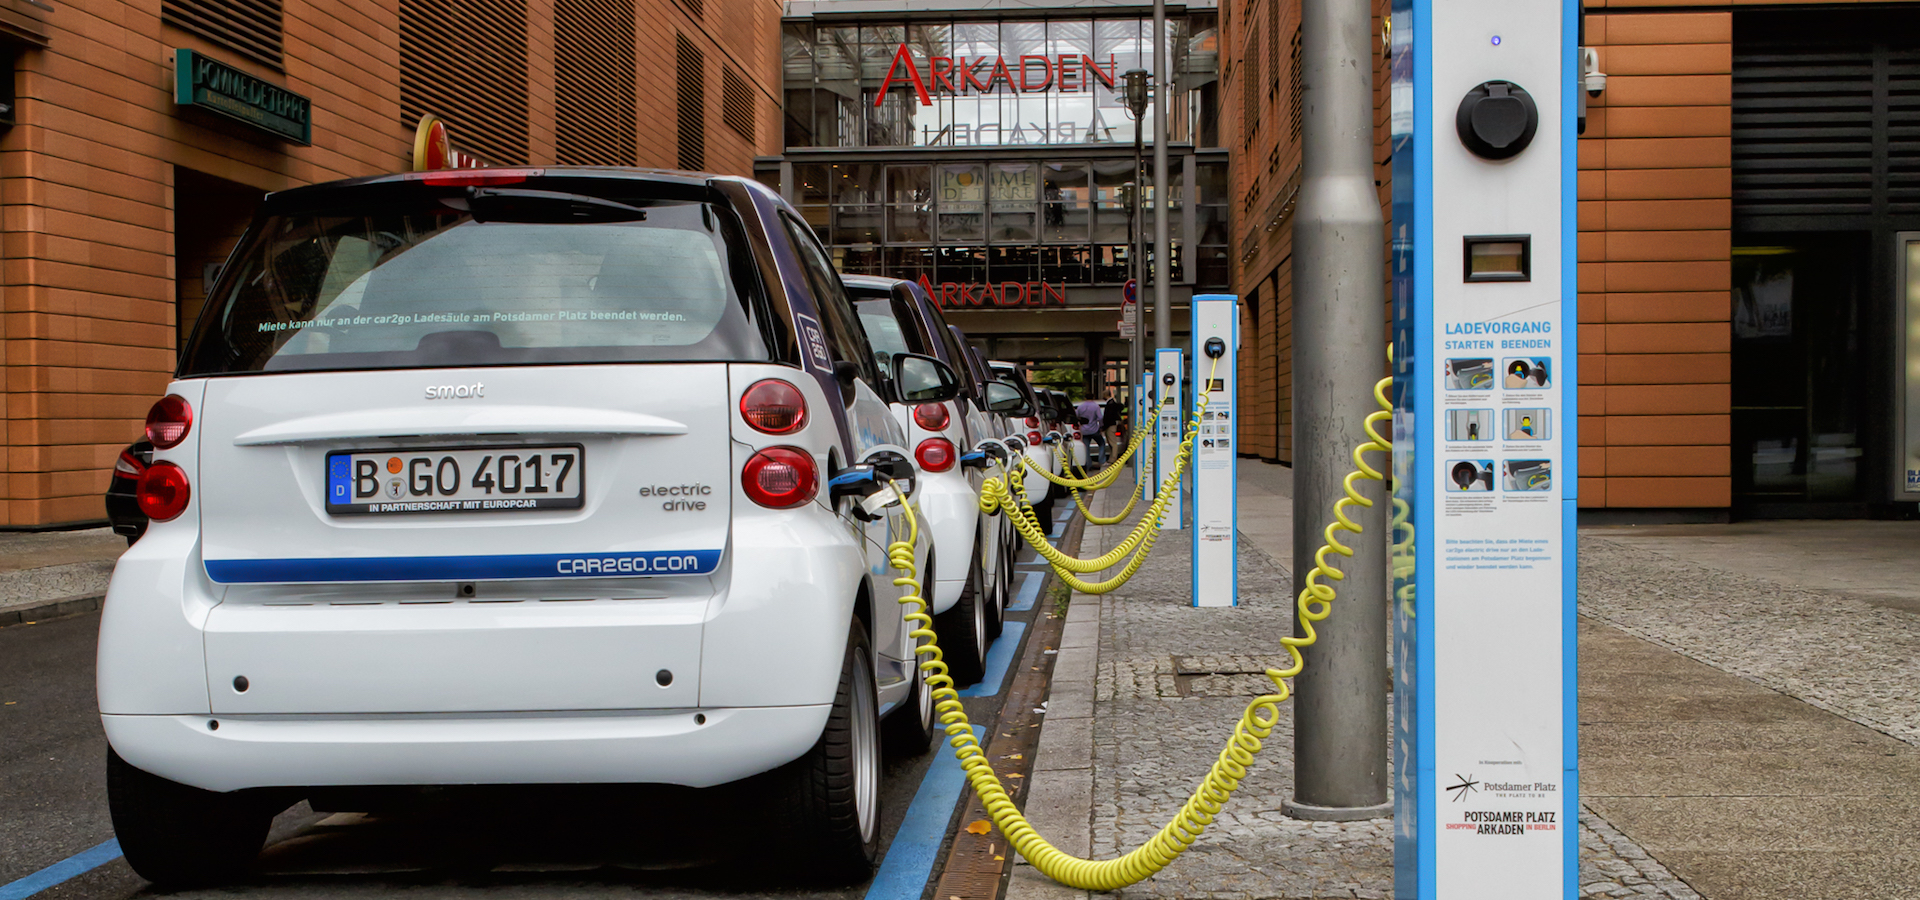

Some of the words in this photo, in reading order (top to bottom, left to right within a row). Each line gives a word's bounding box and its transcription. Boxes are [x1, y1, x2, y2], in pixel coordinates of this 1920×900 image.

[874, 42, 1115, 107] ARKADEN
[194, 58, 247, 100] POMME
[247, 79, 268, 110] DE
[944, 170, 1030, 187] POMME
[944, 187, 967, 200] DE
[917, 273, 1066, 315] ARKADEN
[258, 322, 287, 333] Miete
[289, 319, 314, 330] kann
[317, 318, 335, 327] nur
[337, 317, 350, 326] an
[353, 315, 371, 325] der
[374, 314, 411, 325] car2go
[414, 312, 470, 323] Ladesäule
[473, 314, 490, 322] am
[494, 312, 555, 322] Potsdamer
[559, 310, 587, 320] Platz
[590, 310, 637, 320] beendet
[640, 311, 686, 322] werden.
[1446, 321, 1551, 335] LADEVORGANG
[1445, 340, 1494, 350] STARTEN
[1501, 339, 1551, 349] BEENDEN
[425, 382, 485, 399] smart
[336, 485, 345, 497] D
[355, 460, 379, 498] B
[409, 456, 460, 496] GO
[472, 453, 575, 495] 4017
[639, 481, 712, 497] electric
[369, 504, 379, 513] IN
[382, 502, 461, 512] PARTNERSCHAFT
[464, 501, 481, 510] MIT
[484, 500, 537, 509] EUROPCAR
[662, 497, 706, 512] drive
[557, 555, 698, 574] CAR2GO.COM
[1484, 782, 1532, 792] Potsdamer
[1534, 782, 1556, 792] Platz
[1464, 811, 1524, 823] POTSDAMER
[1526, 811, 1556, 823] PLATZ
[1477, 823, 1524, 835] ARKADEN
